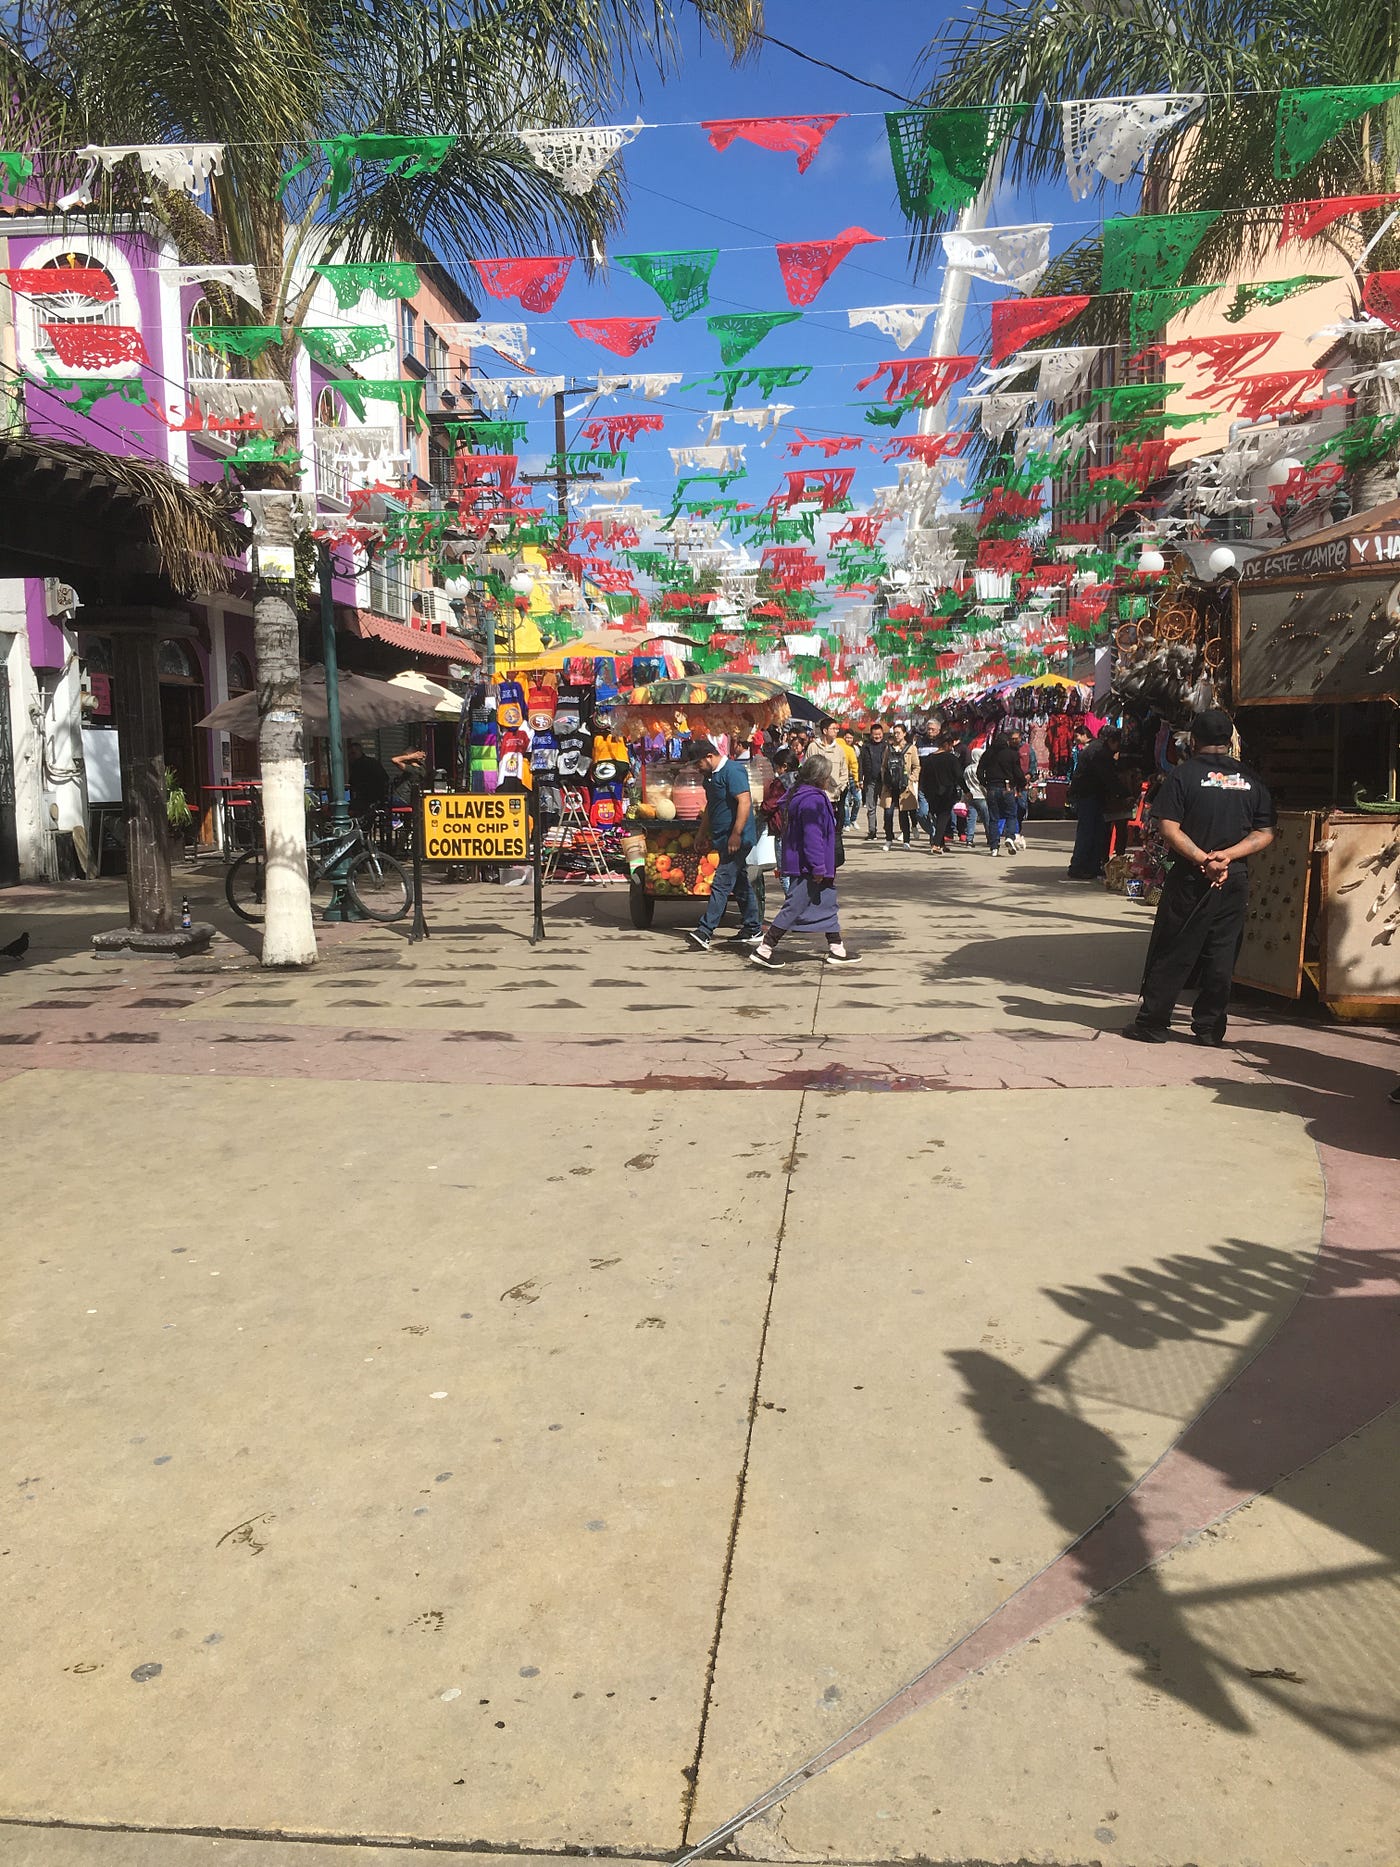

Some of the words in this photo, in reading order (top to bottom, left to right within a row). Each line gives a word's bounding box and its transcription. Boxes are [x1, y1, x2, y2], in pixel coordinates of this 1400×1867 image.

[1264, 554, 1297, 574] ESTE
[1301, 540, 1348, 569] CAMPO
[1352, 538, 1370, 562] Y
[445, 801, 505, 819] LLAVES
[443, 823, 471, 833] CON
[476, 823, 509, 833] CHIP
[429, 838, 524, 856] CONTROLES
